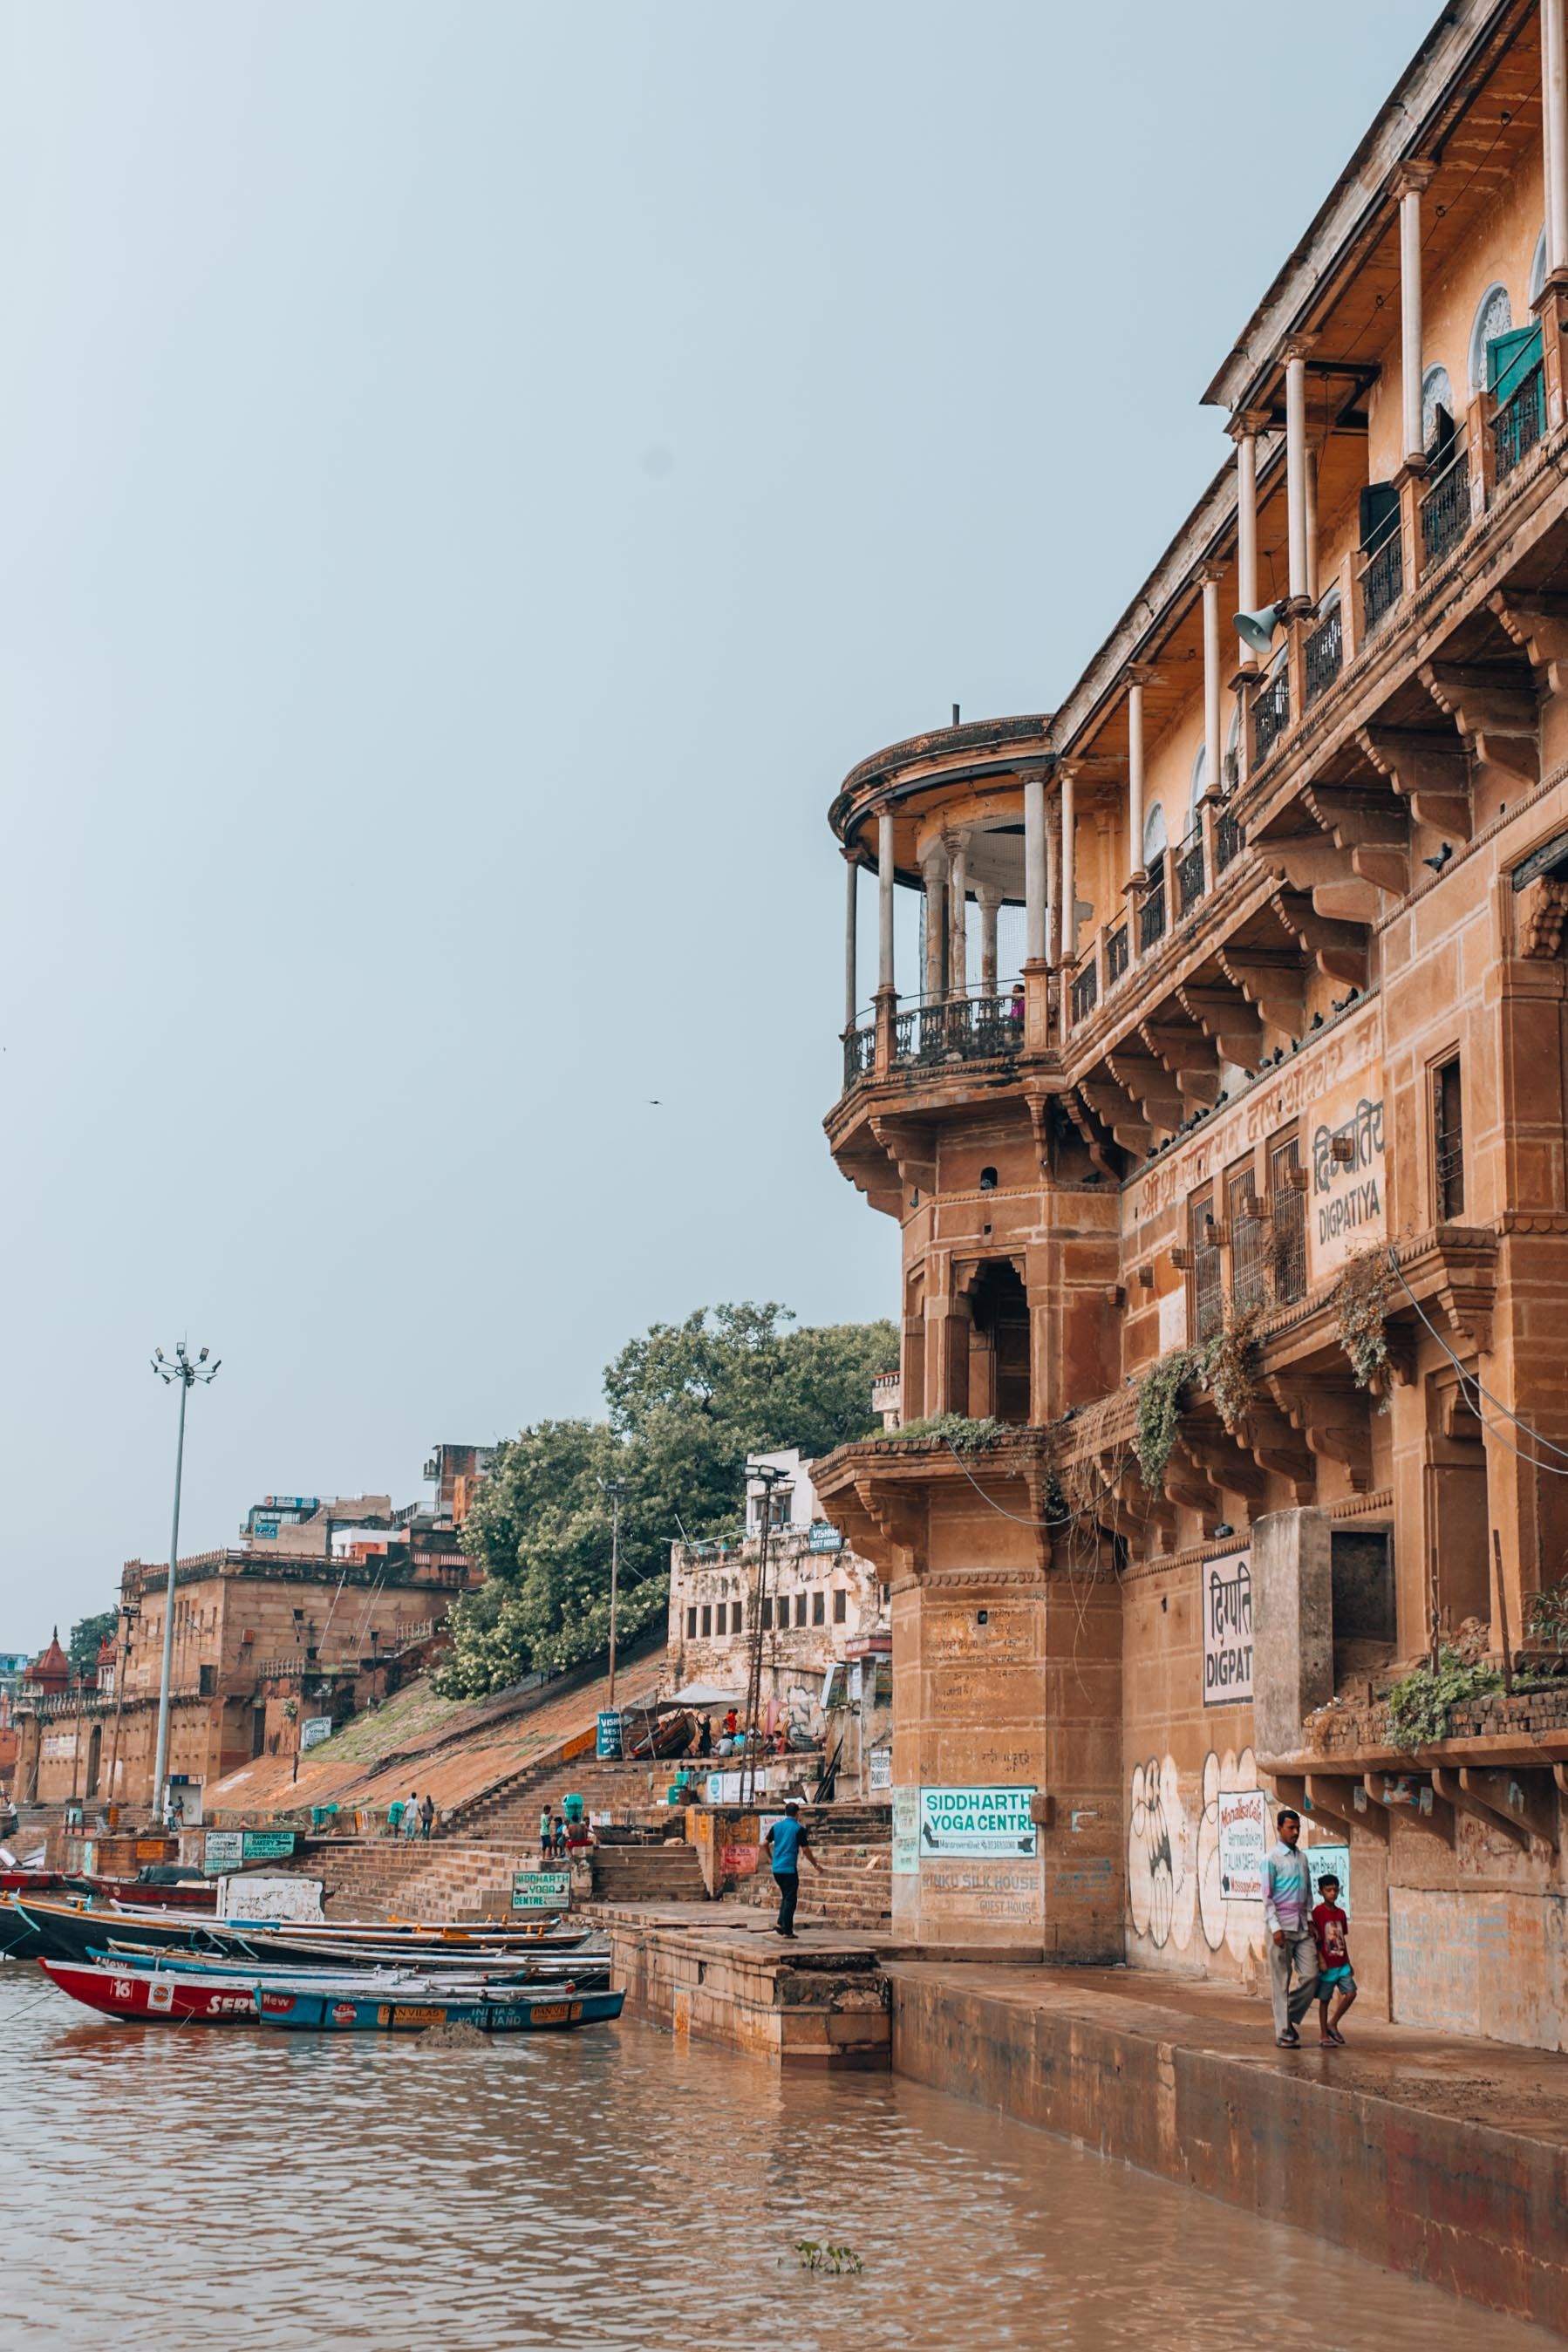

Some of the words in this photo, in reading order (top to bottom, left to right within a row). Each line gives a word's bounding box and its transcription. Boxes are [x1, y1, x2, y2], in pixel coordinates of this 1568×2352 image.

[1319, 1179, 1381, 1245] DIGPATIYA
[810, 1539, 823, 1549] REST
[823, 1537, 840, 1547] HOUSE
[926, 1794, 1032, 1811] SIDDHARTH
[931, 1815, 976, 1831] YOGA
[962, 1874, 991, 1890] SILK
[994, 1876, 1040, 1891] HOUSE
[979, 1899, 1006, 1914] GUEST
[1006, 1900, 1037, 1915] HOUSE
[113, 1980, 131, 1999] 16
[262, 1994, 290, 2008] New
[409, 2008, 440, 2018] VILAS
[553, 2005, 579, 2015] VILS
